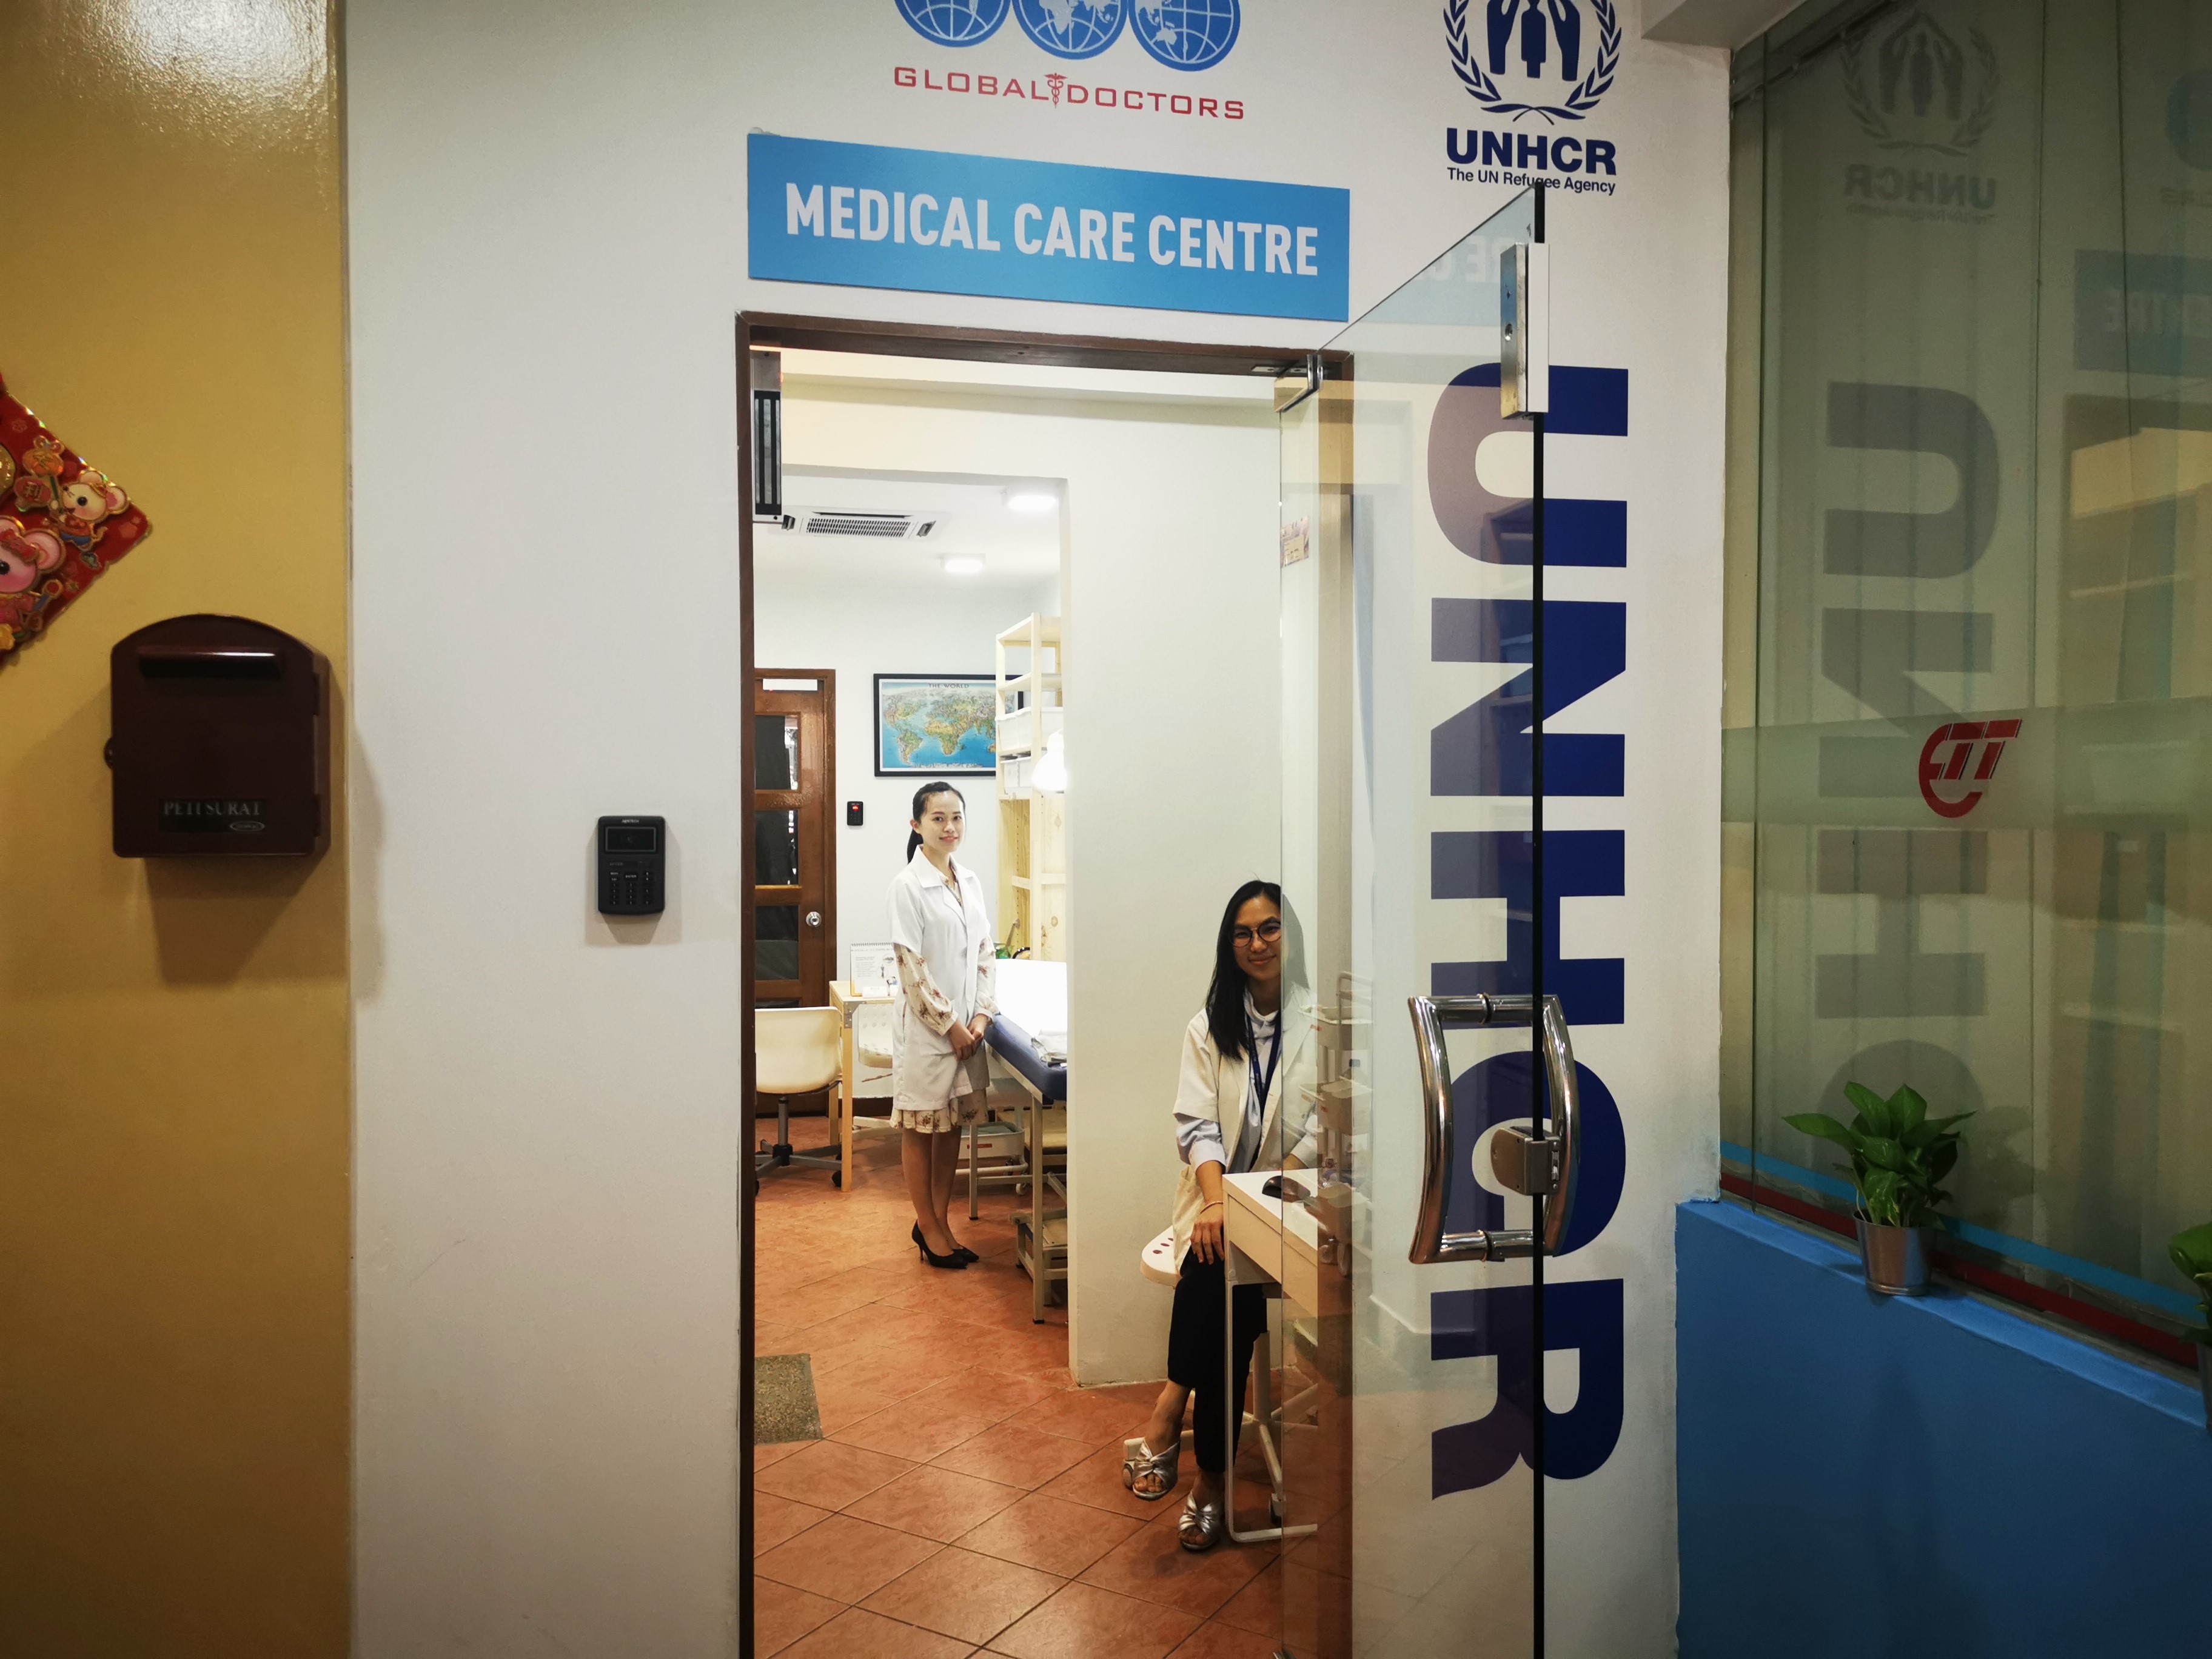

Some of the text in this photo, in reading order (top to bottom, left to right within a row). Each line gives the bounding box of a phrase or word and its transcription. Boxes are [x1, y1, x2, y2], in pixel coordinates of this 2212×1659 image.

[894, 66, 1244, 120] GLOBAL DOCTORS
[1447, 127, 1617, 175] UNHCR
[1447, 167, 1474, 182] The
[1478, 170, 1499, 184] UN
[1564, 176, 1616, 196] Agency
[785, 182, 1319, 276] MEDICAL CARE CENTRE
[1427, 361, 1629, 1501] UNHCR
